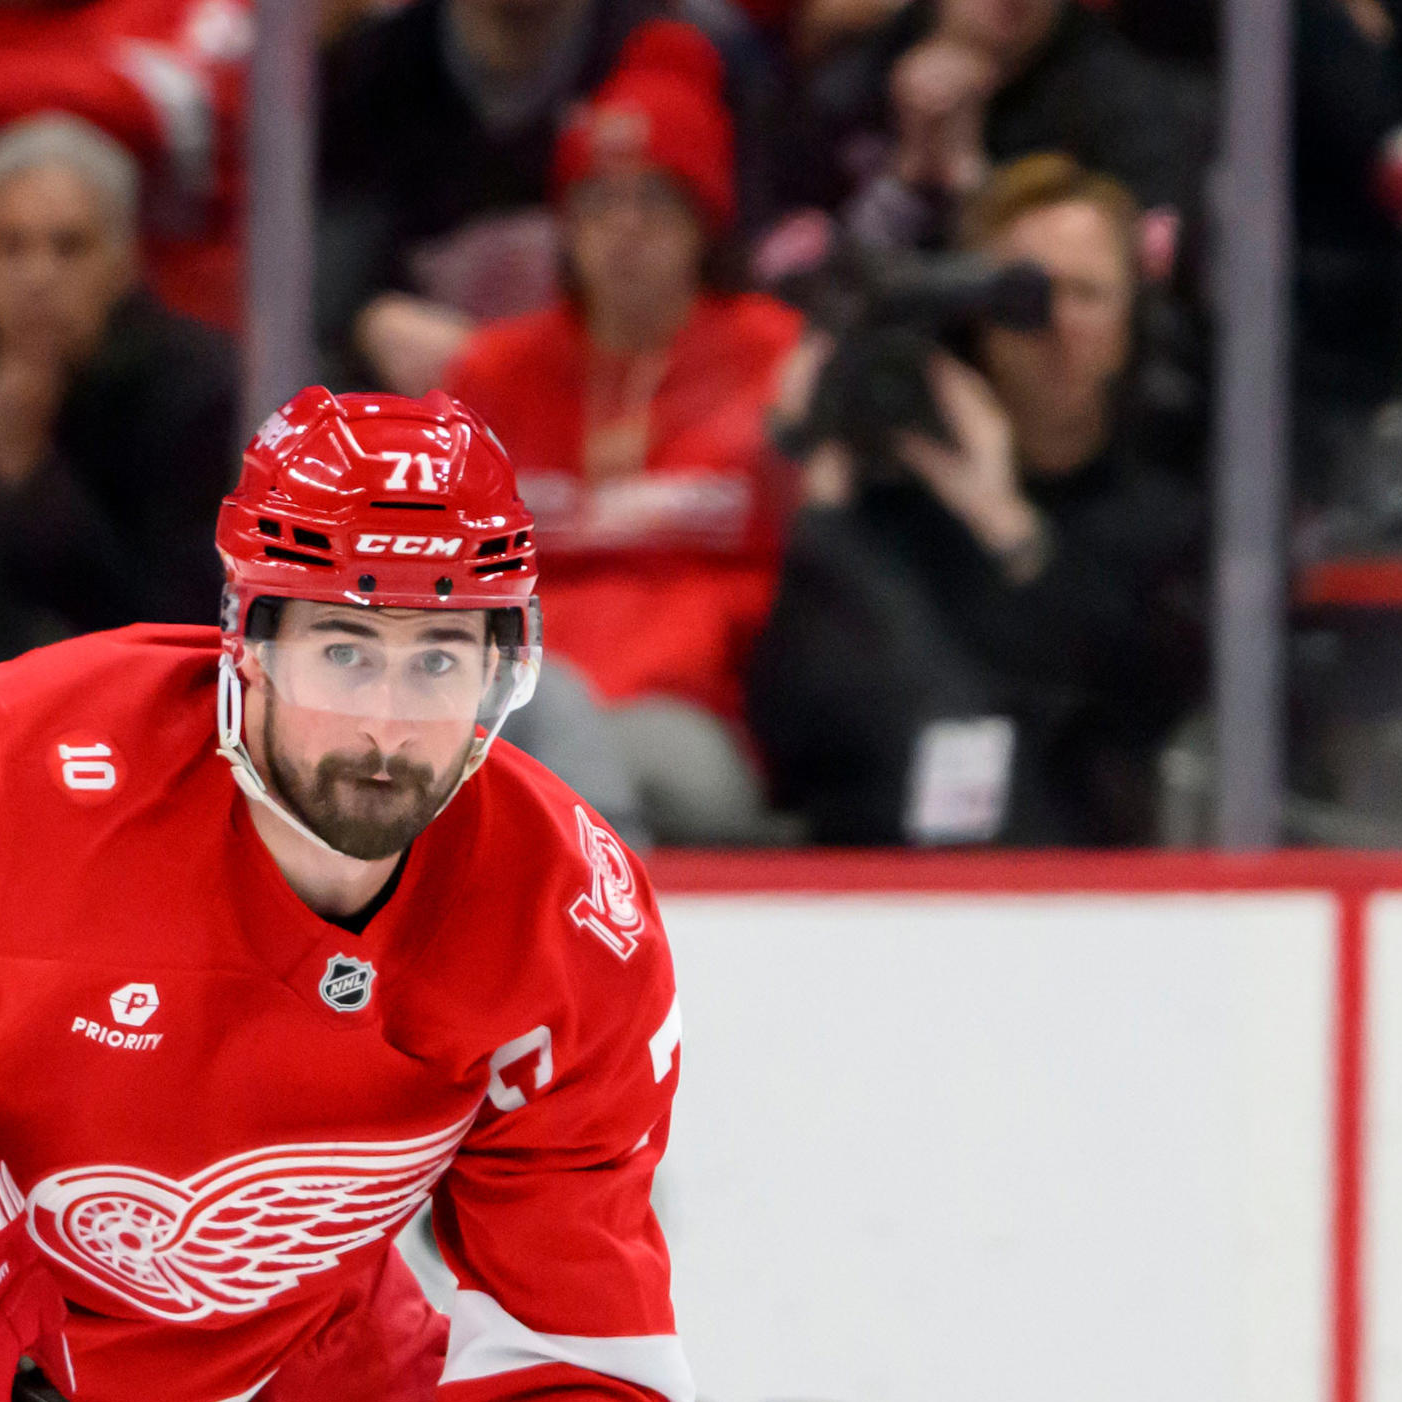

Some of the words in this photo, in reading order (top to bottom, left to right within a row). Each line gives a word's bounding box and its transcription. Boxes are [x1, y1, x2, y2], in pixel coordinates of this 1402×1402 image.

[382, 451, 438, 491] 71
[355, 534, 463, 557] CCM
[58, 743, 116, 790] 10
[330, 973, 365, 996] NHL
[71, 1016, 164, 1051] PRIORITY
[487, 1024, 554, 1112] C
